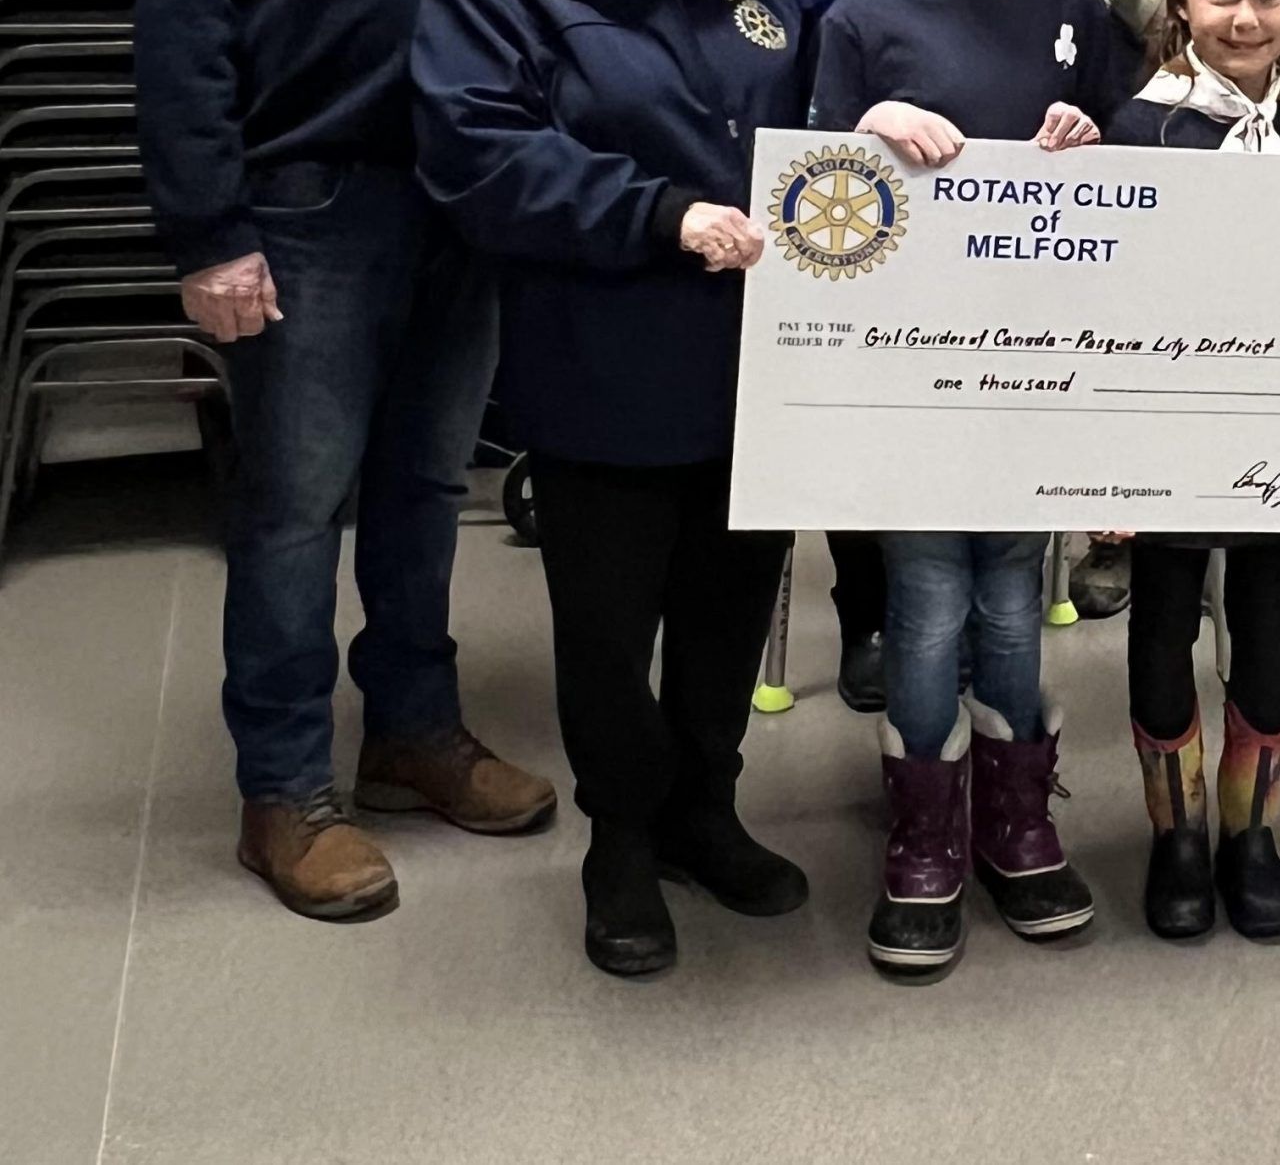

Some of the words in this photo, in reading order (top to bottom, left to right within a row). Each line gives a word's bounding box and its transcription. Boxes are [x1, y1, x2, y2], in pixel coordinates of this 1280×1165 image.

[811, 158, 869, 179] ROTARY
[933, 177, 1064, 205] ROTARY
[1073, 183, 1157, 209] CLUB
[1030, 210, 1061, 233] of
[966, 235, 1119, 262] MELFORT
[778, 321, 801, 333] PAY
[806, 322, 824, 333] TO
[828, 322, 855, 334] THE
[828, 337, 846, 348] OF
[864, 326, 903, 347] Girl
[905, 326, 965, 348] Guides
[968, 328, 989, 350] of
[1194, 336, 1276, 355] District
[933, 377, 963, 391] one
[979, 371, 1076, 392] thousand
[1036, 484, 1107, 498] Authorized
[1111, 485, 1173, 499] Signature
